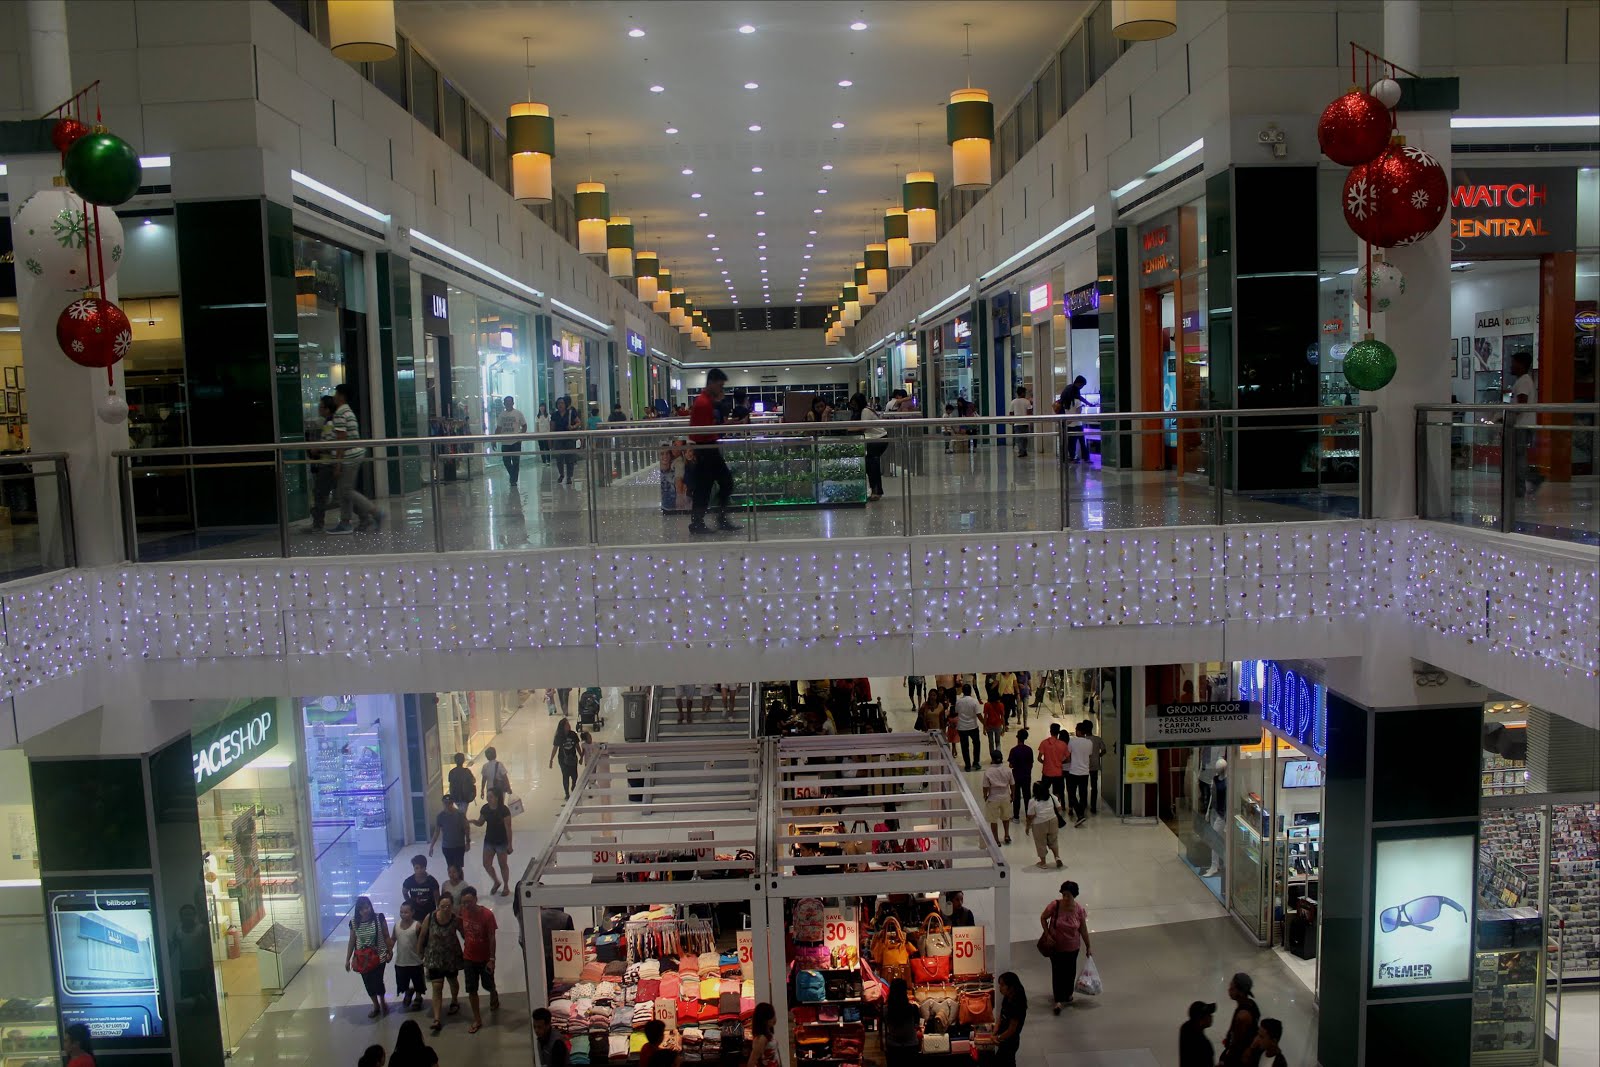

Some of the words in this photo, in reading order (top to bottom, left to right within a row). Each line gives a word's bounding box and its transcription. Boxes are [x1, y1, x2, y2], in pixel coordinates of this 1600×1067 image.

[1451, 183, 1547, 208] WATCH
[1477, 317, 1500, 329] ALBA
[1509, 316, 1530, 326] CITIZEN
[1166, 705, 1208, 715] GROUND
[1210, 703, 1241, 713] FLOOR
[1210, 714, 1248, 722] ELEVATOR
[1164, 727, 1211, 735] RESTROOMS
[826, 922, 855, 941] 30%
[555, 945, 580, 962] 50%
[955, 941, 982, 959] 50%
[1378, 962, 1432, 979] PREMIER
